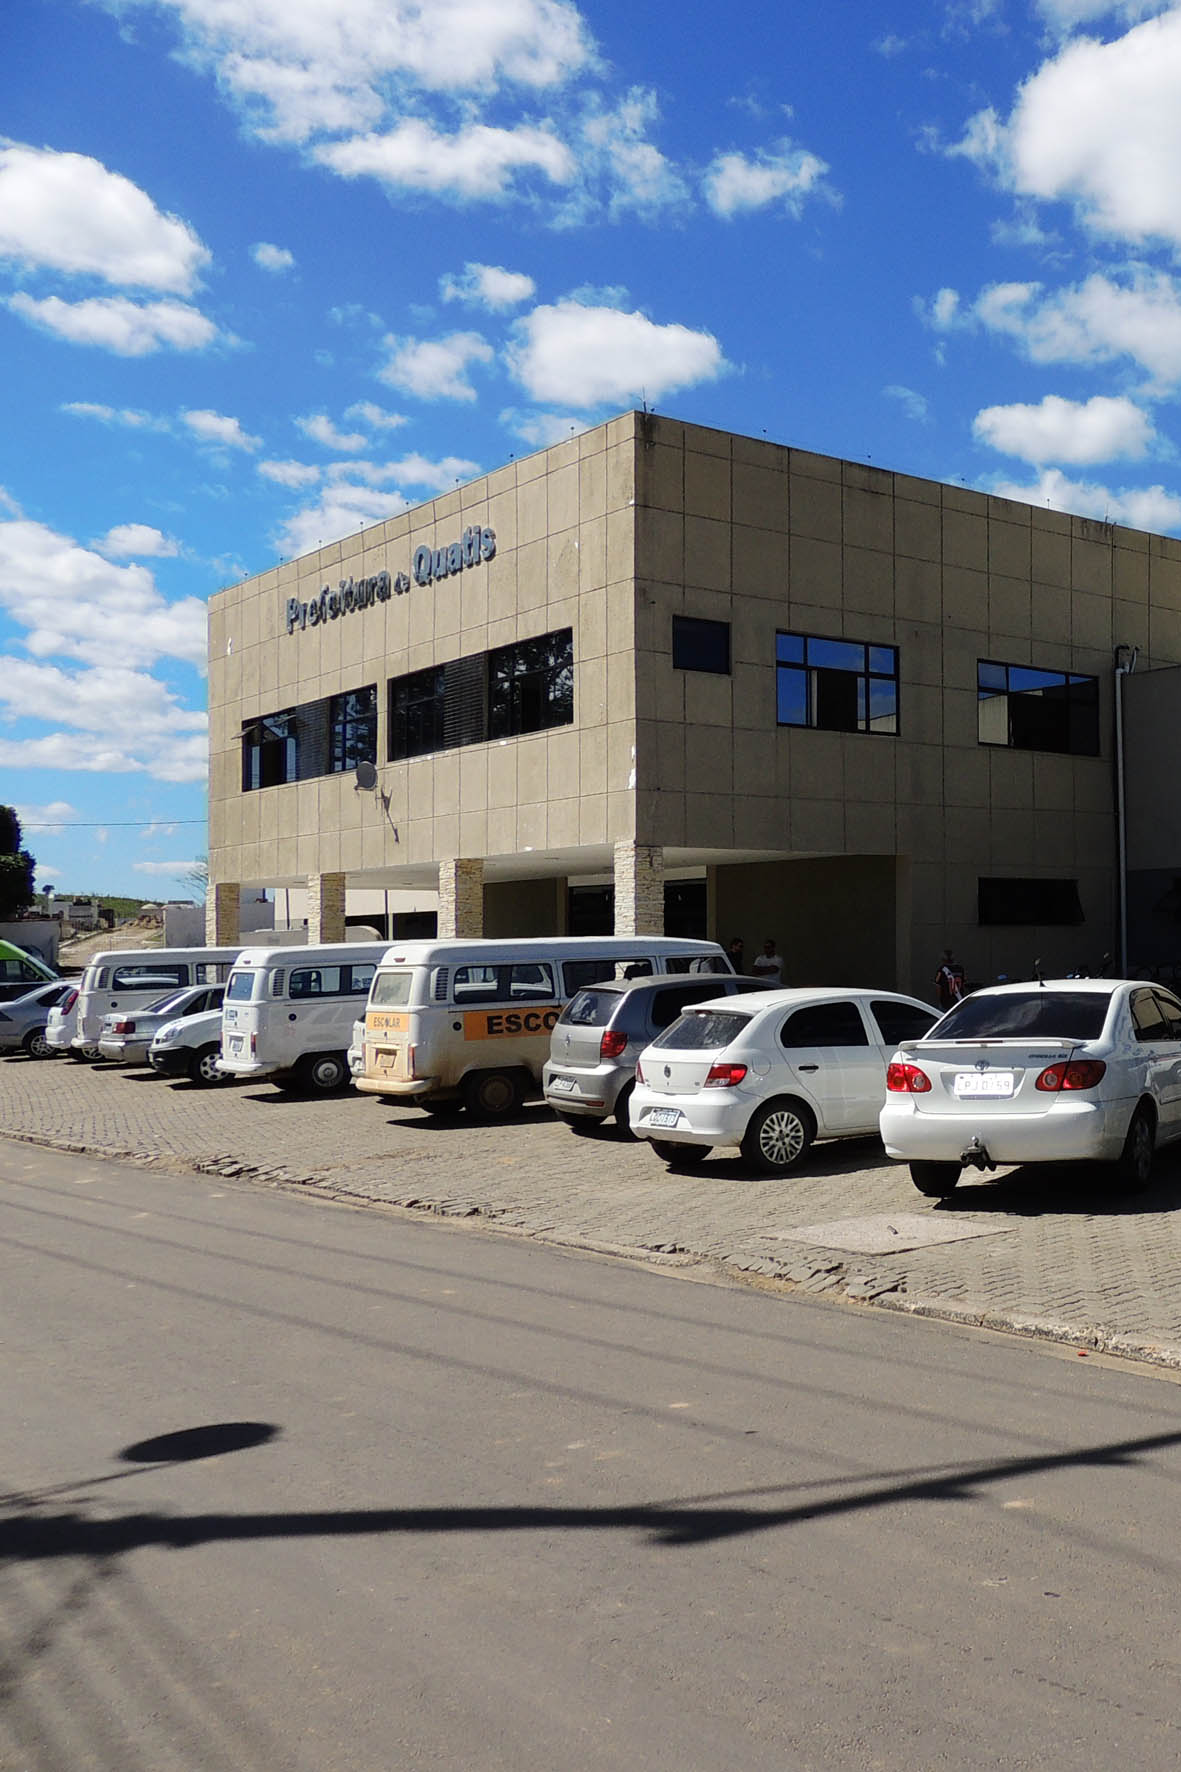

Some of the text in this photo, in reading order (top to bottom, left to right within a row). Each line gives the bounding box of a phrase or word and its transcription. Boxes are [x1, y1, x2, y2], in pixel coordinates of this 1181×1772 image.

[286, 525, 496, 635] Prefeitura de Quatis
[373, 1016, 401, 1028] ESCOLAR
